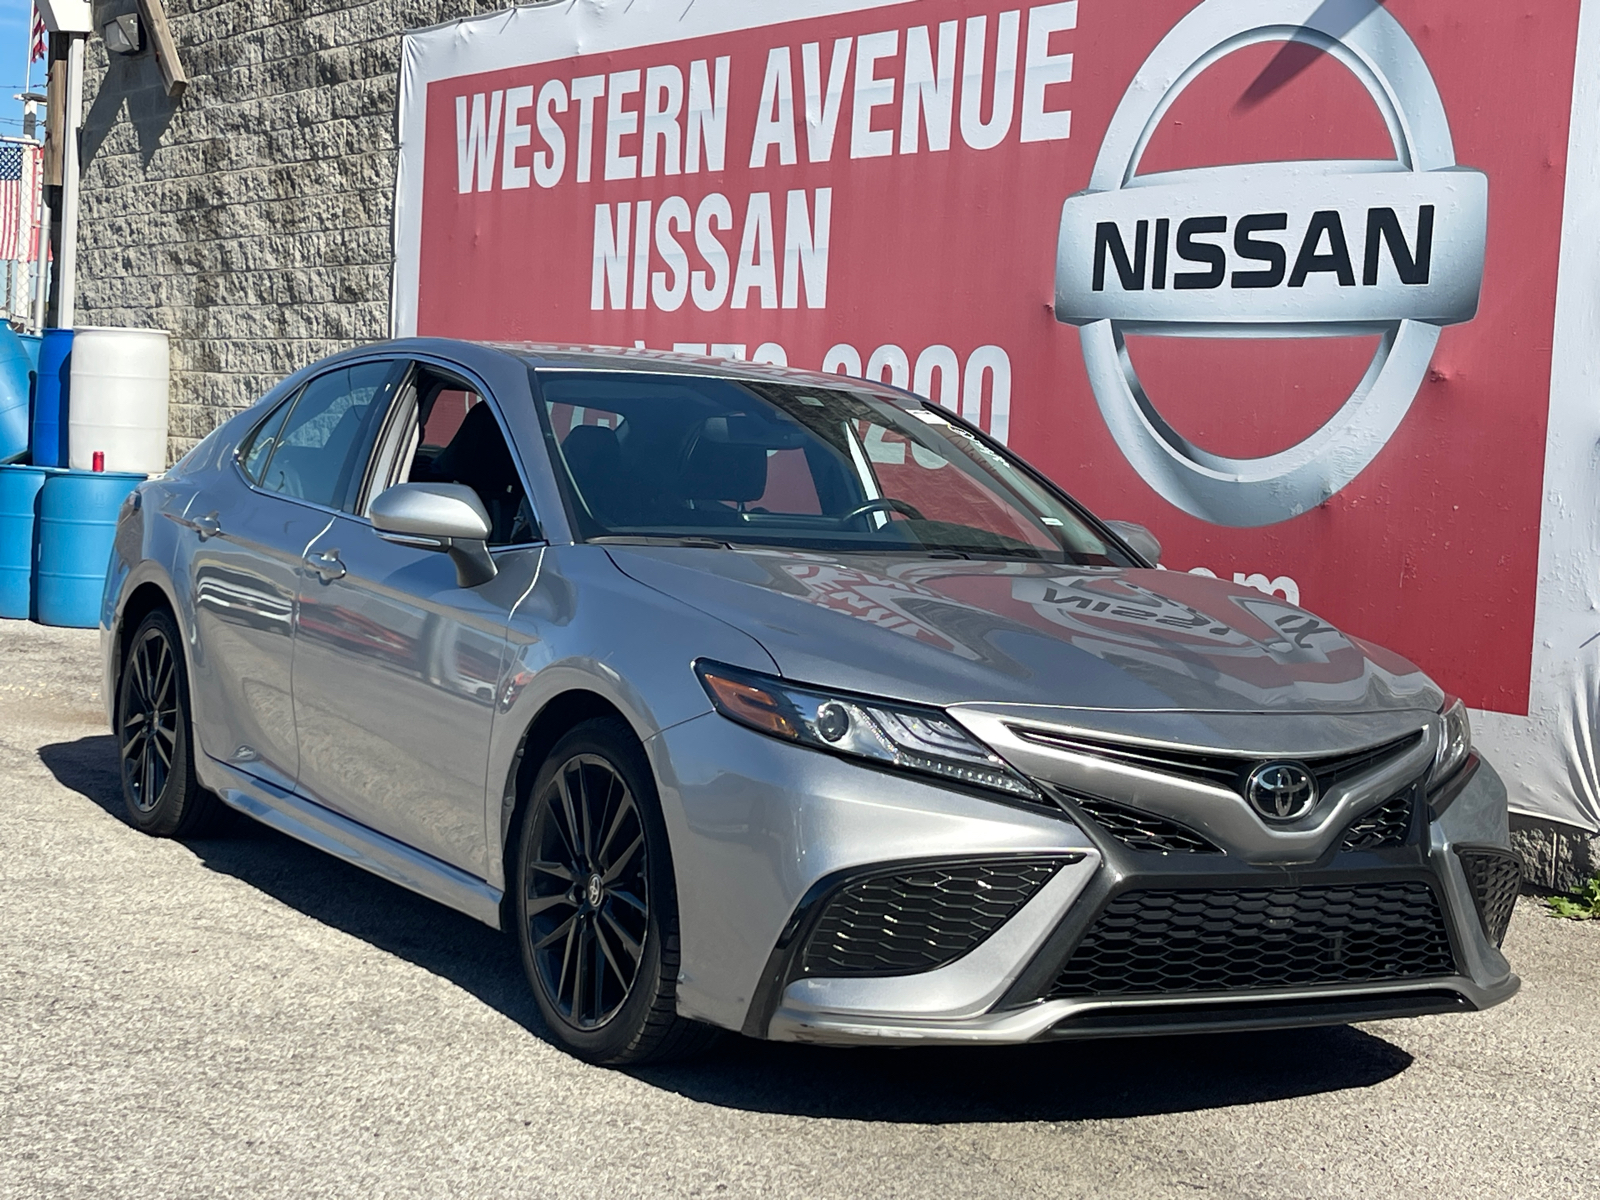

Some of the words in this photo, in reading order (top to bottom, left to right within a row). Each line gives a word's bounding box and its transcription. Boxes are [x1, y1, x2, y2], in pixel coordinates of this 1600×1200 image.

[455, 55, 731, 194] WESTERN
[749, 0, 1079, 169] AVENUE
[590, 187, 833, 312] NISSAN
[1092, 204, 1435, 292] NISSAN
